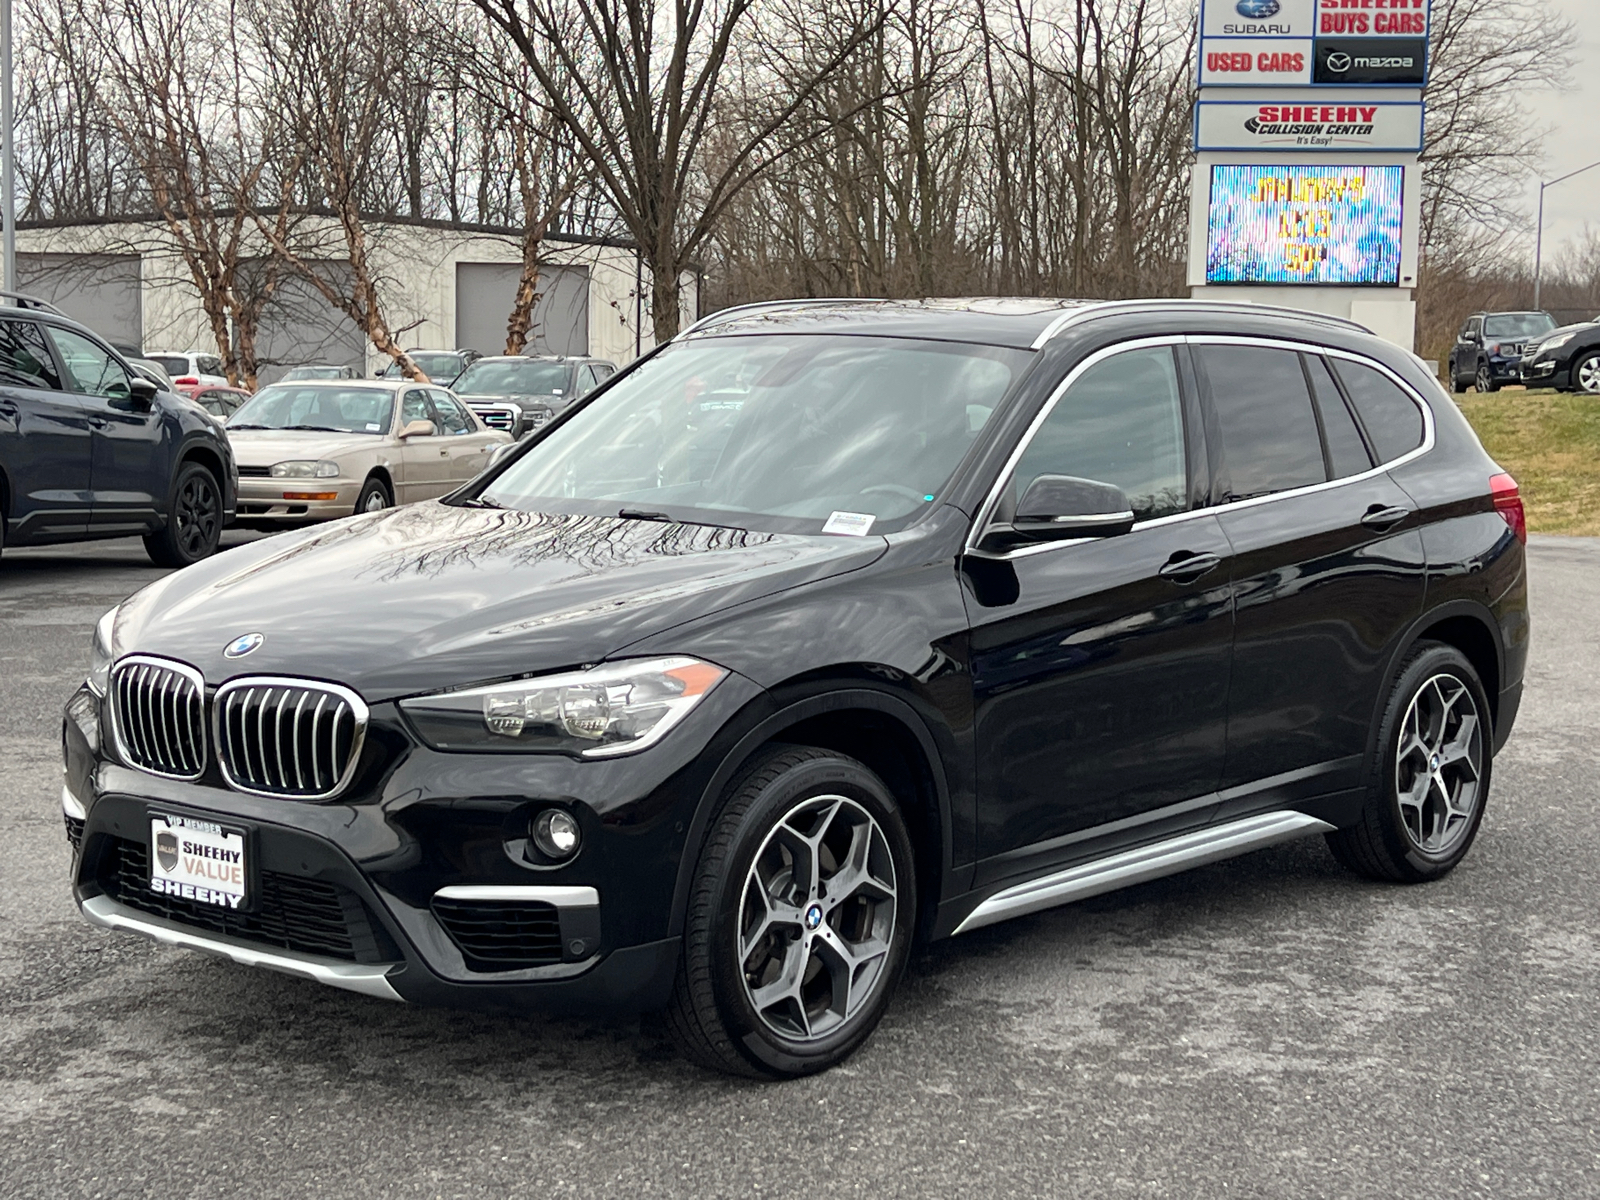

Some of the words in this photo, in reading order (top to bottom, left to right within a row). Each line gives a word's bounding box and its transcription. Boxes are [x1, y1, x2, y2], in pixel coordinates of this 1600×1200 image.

[1223, 24, 1291, 34] SUBARU
[1320, 12, 1370, 34] BUYS
[1374, 12, 1425, 34] CARS
[1207, 52, 1252, 72] USED
[1257, 52, 1304, 73] CARS
[1354, 57, 1414, 68] mazda
[1258, 107, 1378, 123] SHEEHY
[1258, 124, 1324, 135] COLLISION
[1325, 124, 1374, 135] CENTER
[1296, 136, 1308, 146] It's
[1310, 136, 1333, 147] Easy!
[167, 815, 182, 827] VIP
[183, 818, 222, 834] MEMBER
[183, 841, 241, 864] SHEEHY
[183, 856, 242, 885] VALUE
[151, 878, 245, 909] SHEEHY
